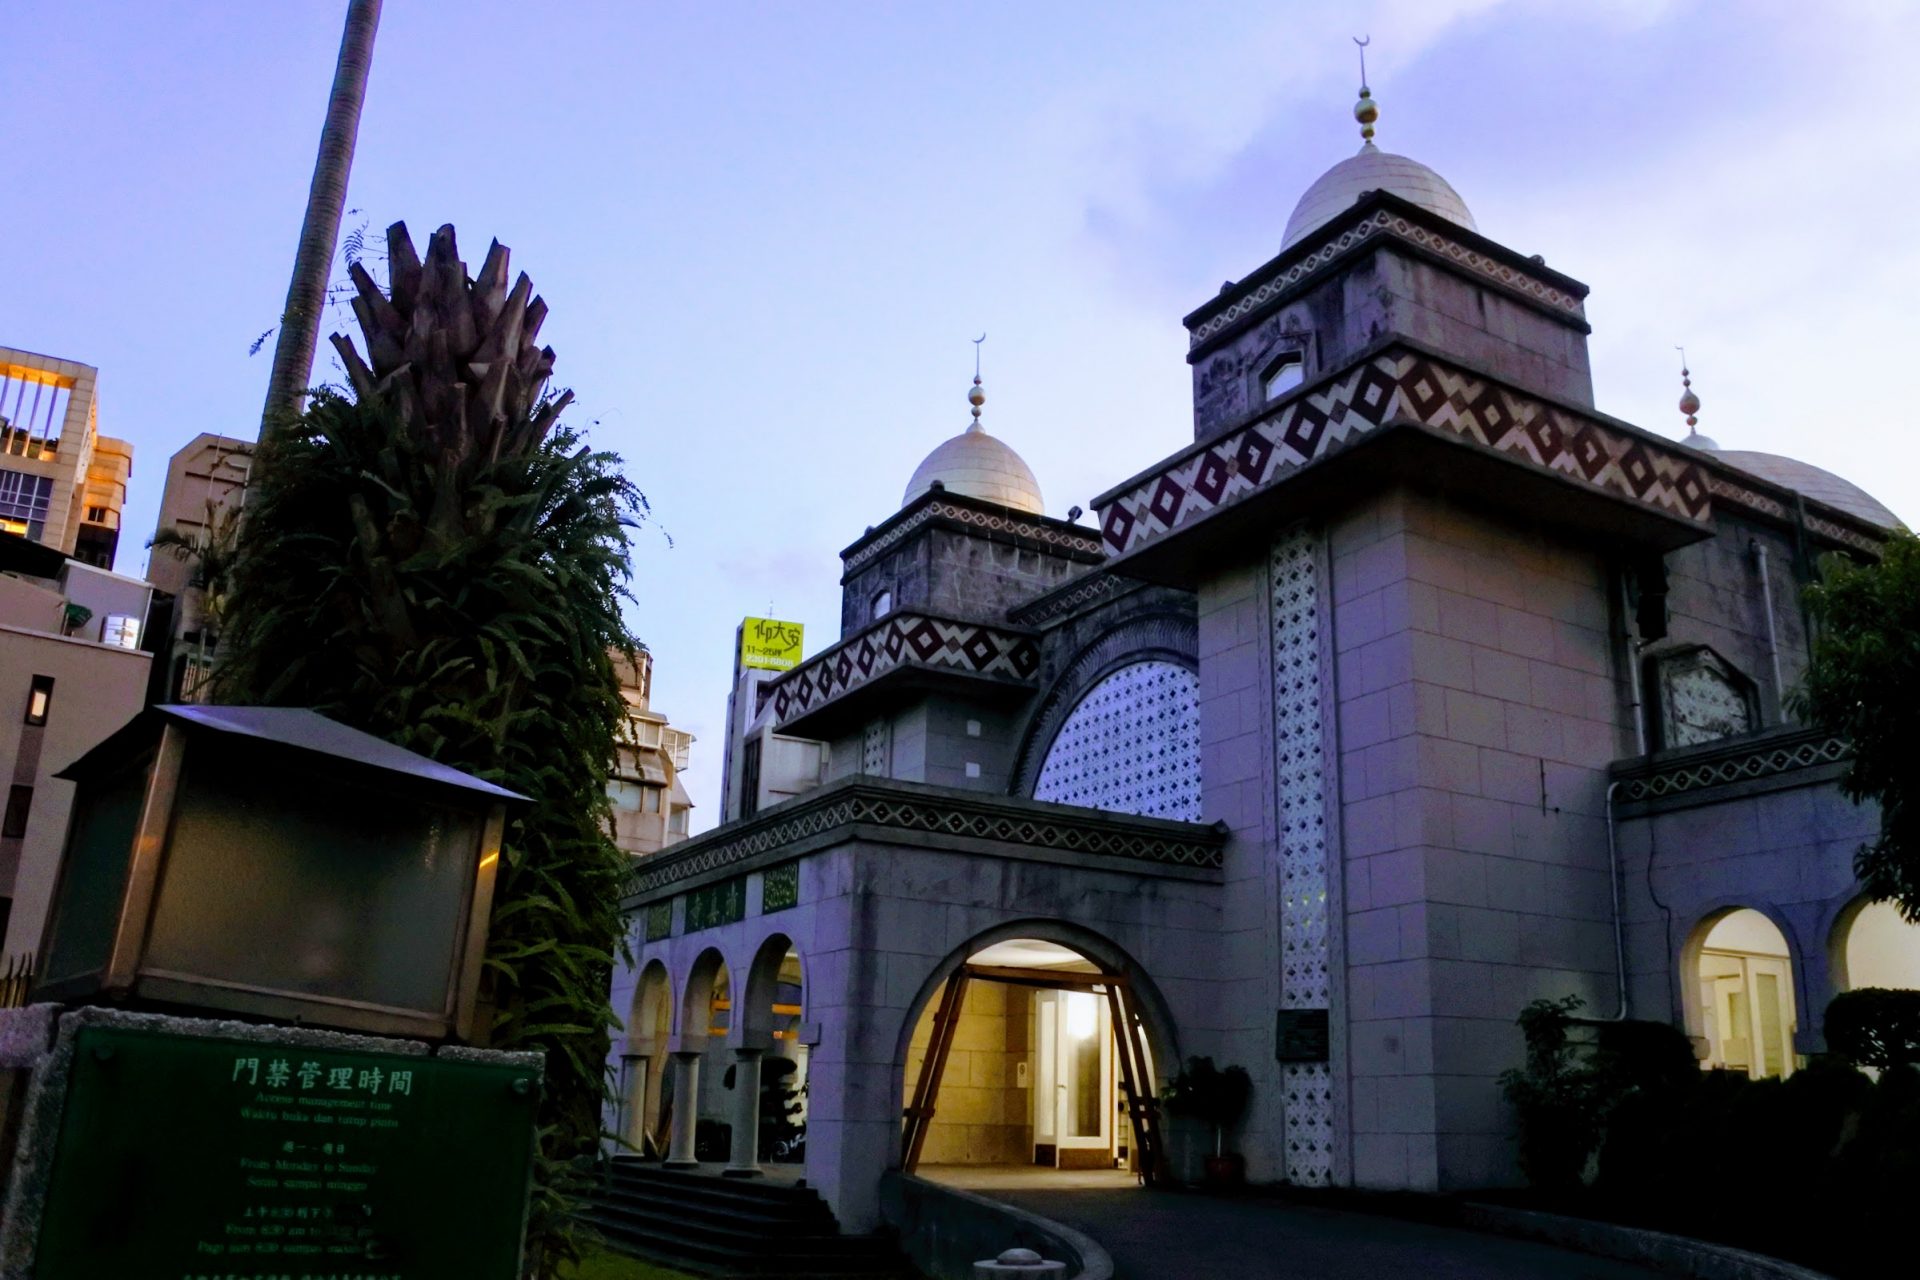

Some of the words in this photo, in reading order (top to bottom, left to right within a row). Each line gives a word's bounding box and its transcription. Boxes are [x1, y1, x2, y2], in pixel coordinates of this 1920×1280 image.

[231, 1057, 413, 1097] 門禁管理時間
